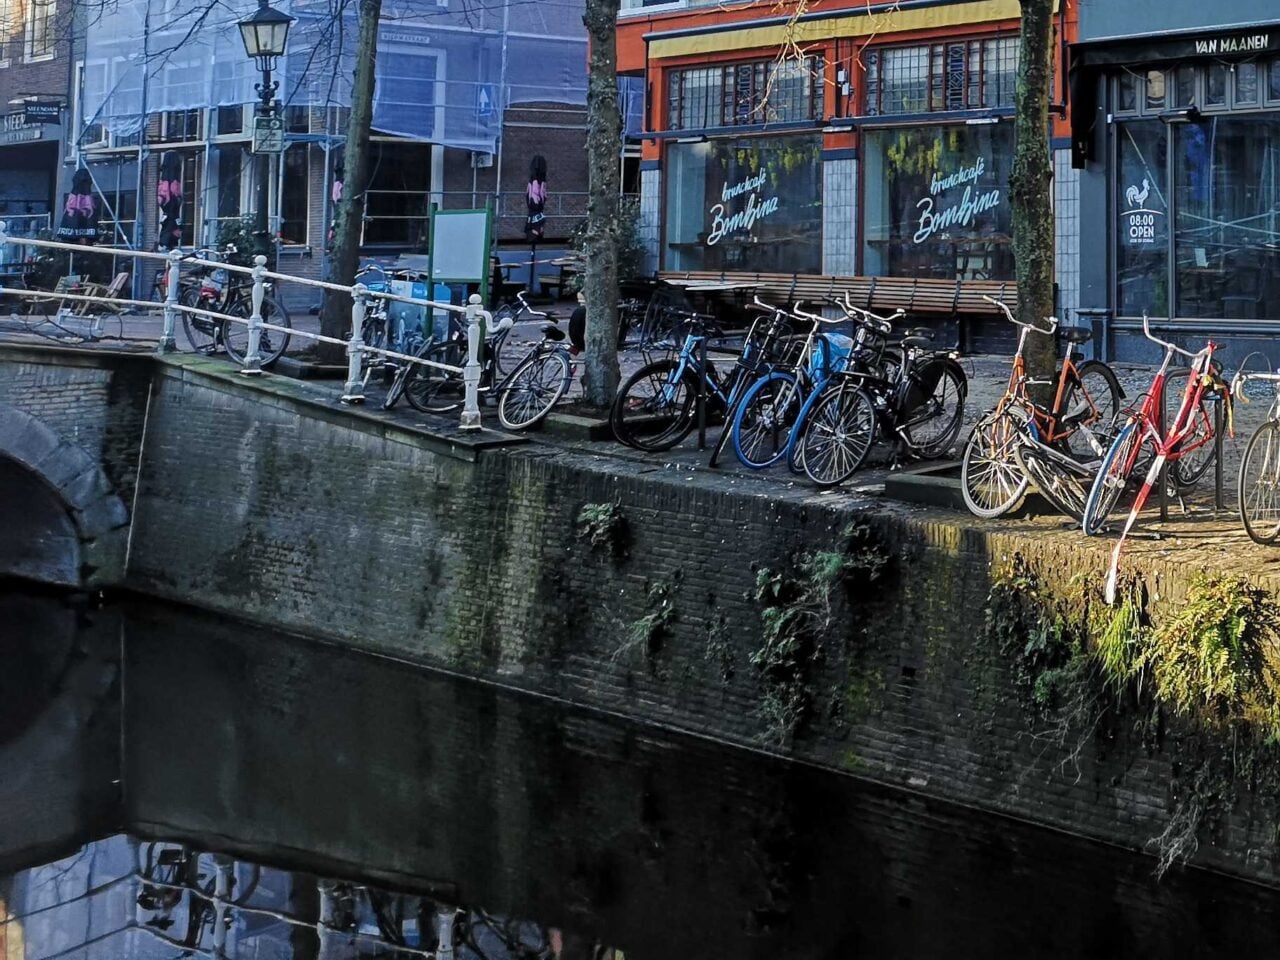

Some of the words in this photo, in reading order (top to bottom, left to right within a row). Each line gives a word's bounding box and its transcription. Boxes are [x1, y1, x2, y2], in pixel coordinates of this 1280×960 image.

[1195, 40, 1217, 54] VAN
[1220, 35, 1268, 53] MAANEN
[722, 167, 766, 202] brunchcafé
[930, 156, 984, 195] brunchcafé
[707, 193, 778, 246] Bombina
[913, 186, 999, 243] Bombina
[1129, 226, 1154, 238] OPEN
[1130, 214, 1154, 226] 08:00
